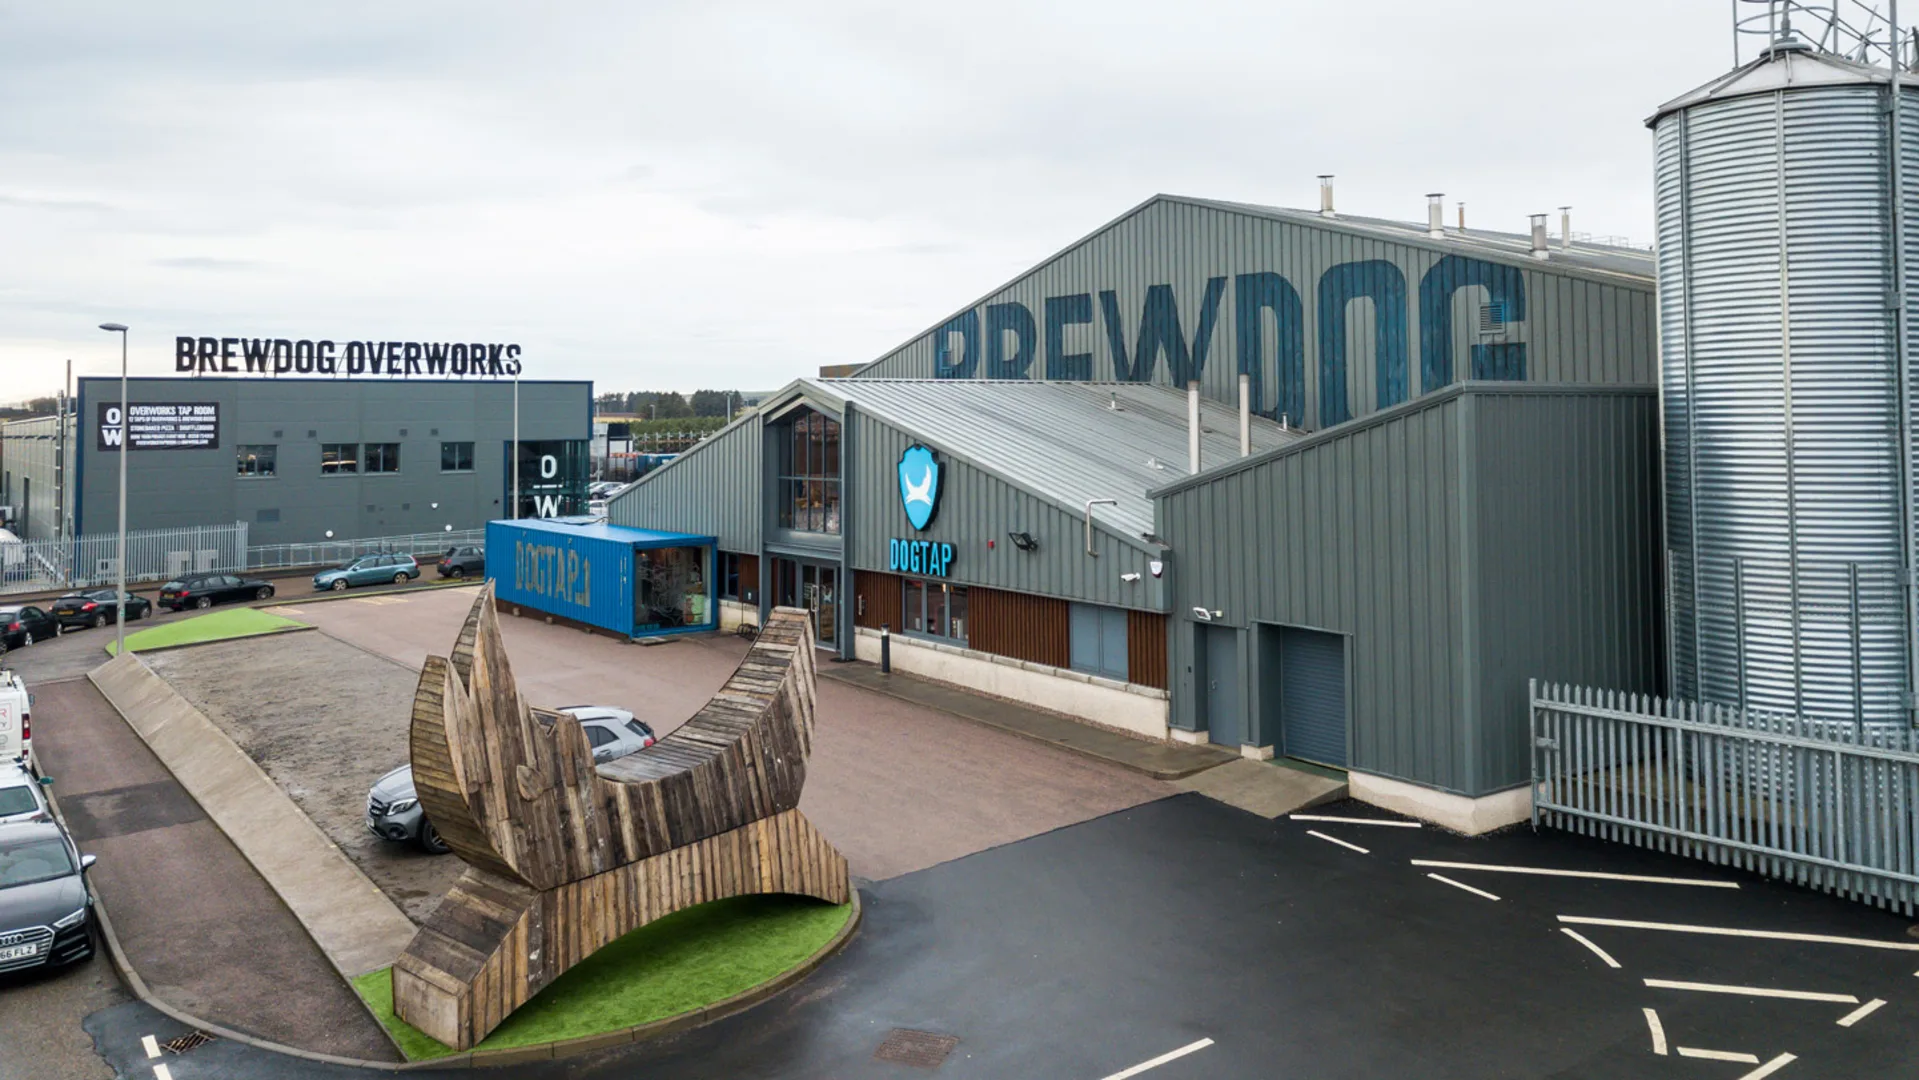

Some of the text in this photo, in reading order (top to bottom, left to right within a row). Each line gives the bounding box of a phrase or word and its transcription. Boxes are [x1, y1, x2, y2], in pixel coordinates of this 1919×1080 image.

[176, 337, 522, 376] BREWDOG OVERWORKS
[130, 406, 215, 415] OVERWORKS TAP ROOM
[541, 455, 557, 479] O
[533, 495, 562, 518] W
[890, 538, 952, 577] DOGTAP
[14, 946, 33, 957] FLZ
